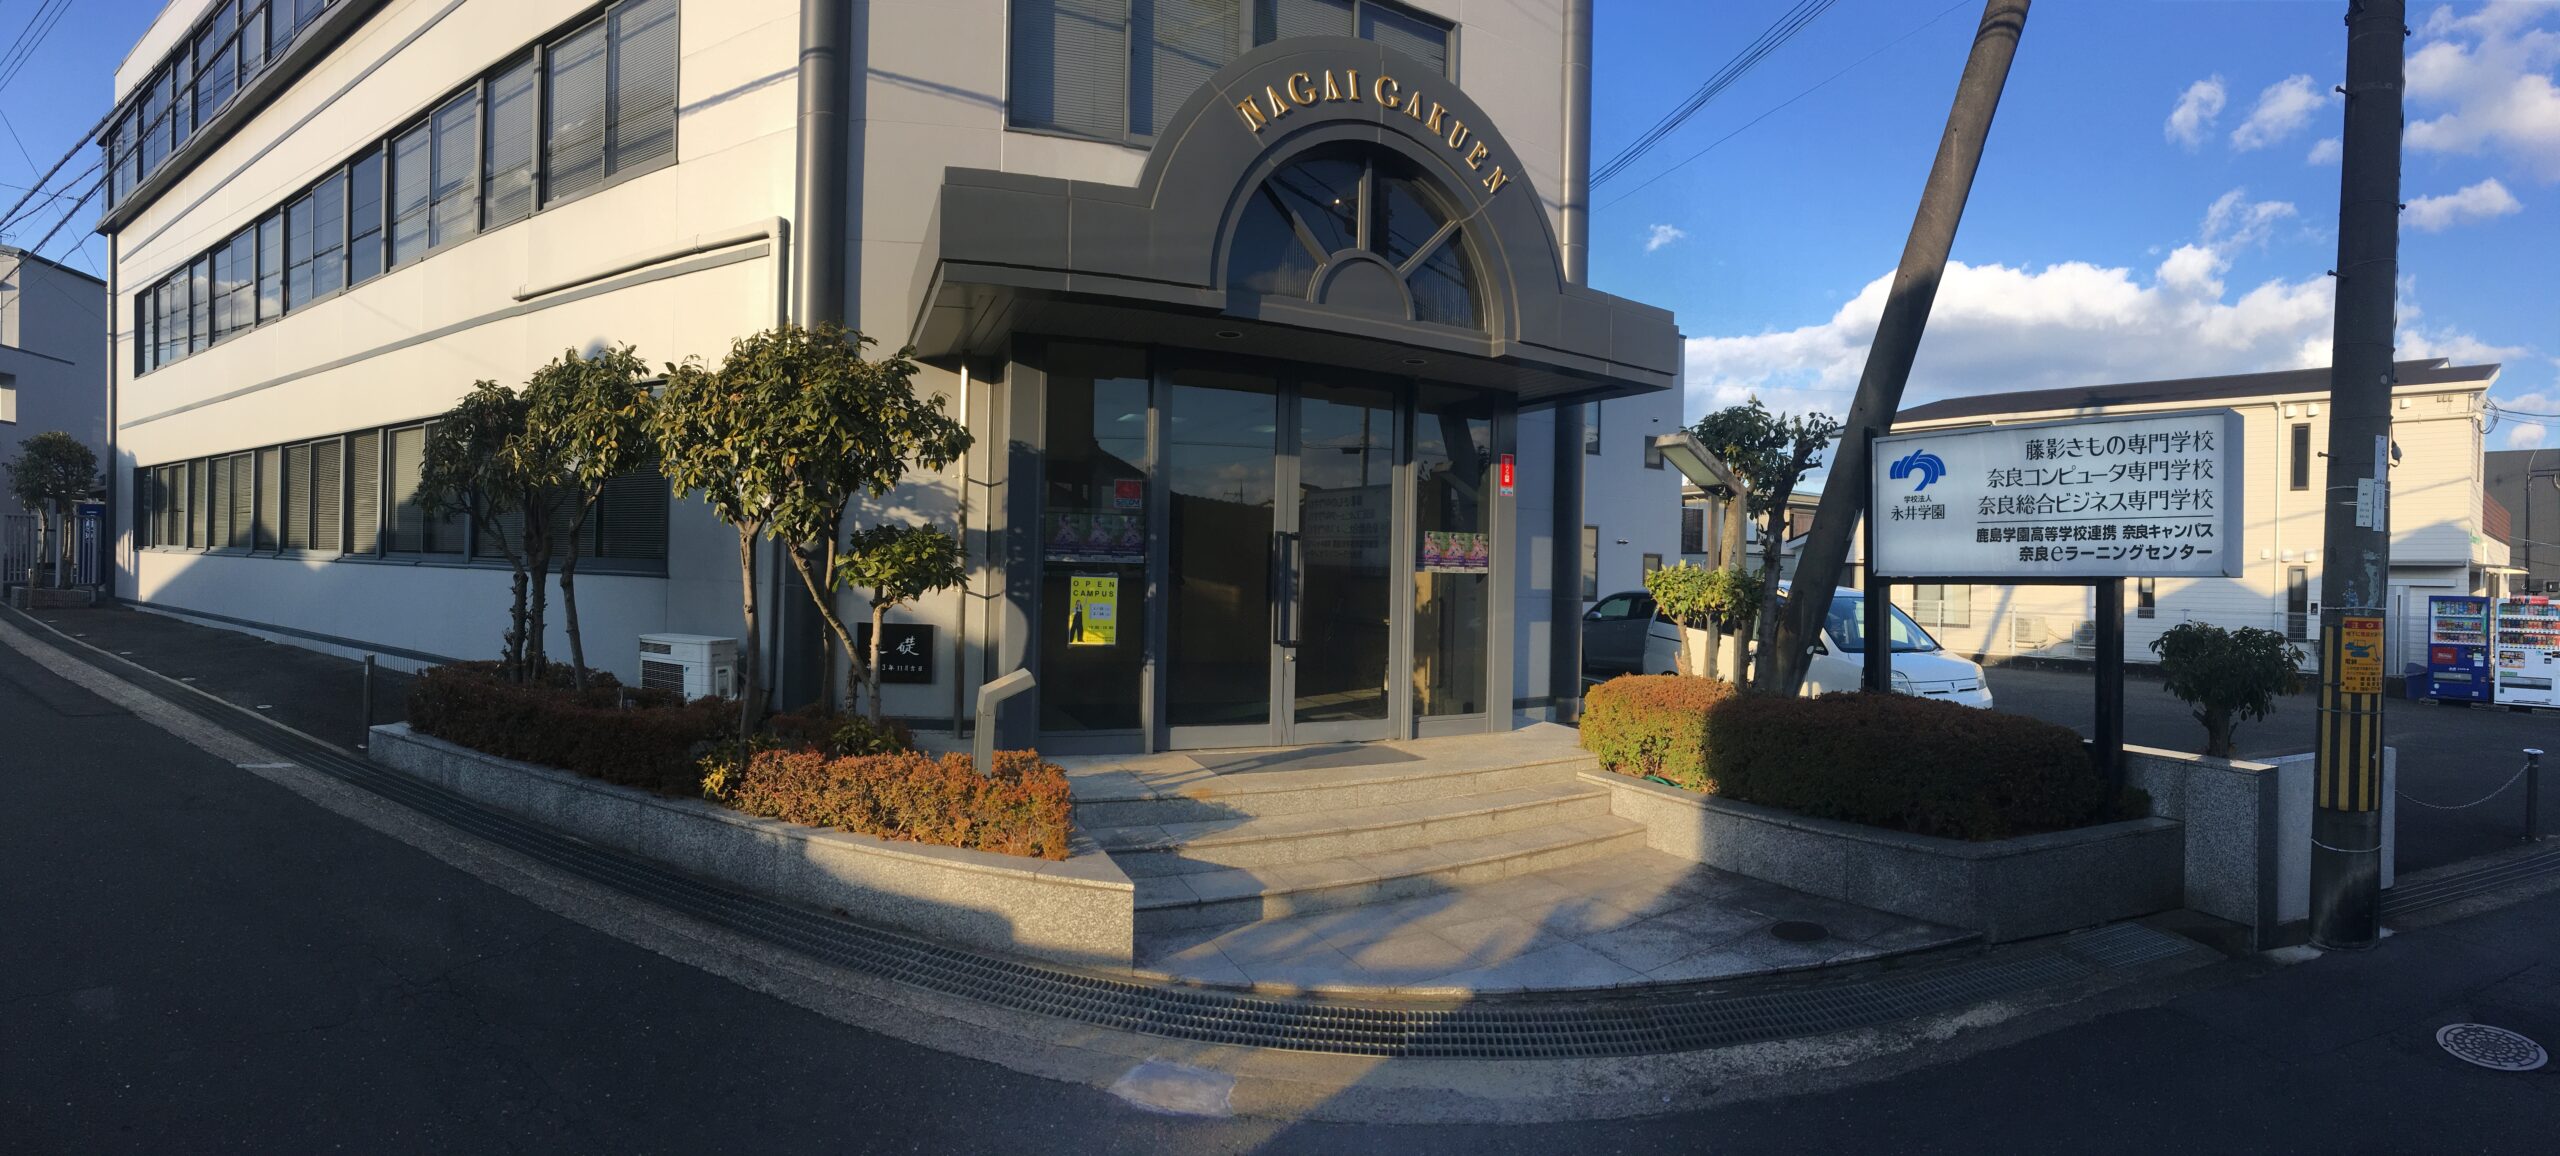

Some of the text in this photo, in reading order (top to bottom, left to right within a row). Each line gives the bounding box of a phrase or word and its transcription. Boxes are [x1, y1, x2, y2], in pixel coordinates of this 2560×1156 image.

[1236, 69, 1510, 195] NAGAI GAKUEN
[2025, 430, 2214, 460] 藤影きもの専門学校
[1986, 459, 2213, 488] 奈良コンピュータ専門学校
[1903, 495, 1933, 503] 学校法人
[1978, 488, 2213, 515] 奈良総合ビジネス専門学校
[1891, 504, 1946, 521] 永井学園
[1976, 521, 2214, 543] 鹿島学園高等学校連携 奈良キャンパス
[2019, 545, 2213, 562] 奈良eラーニングセンター
[1073, 580, 1115, 588] OPEN
